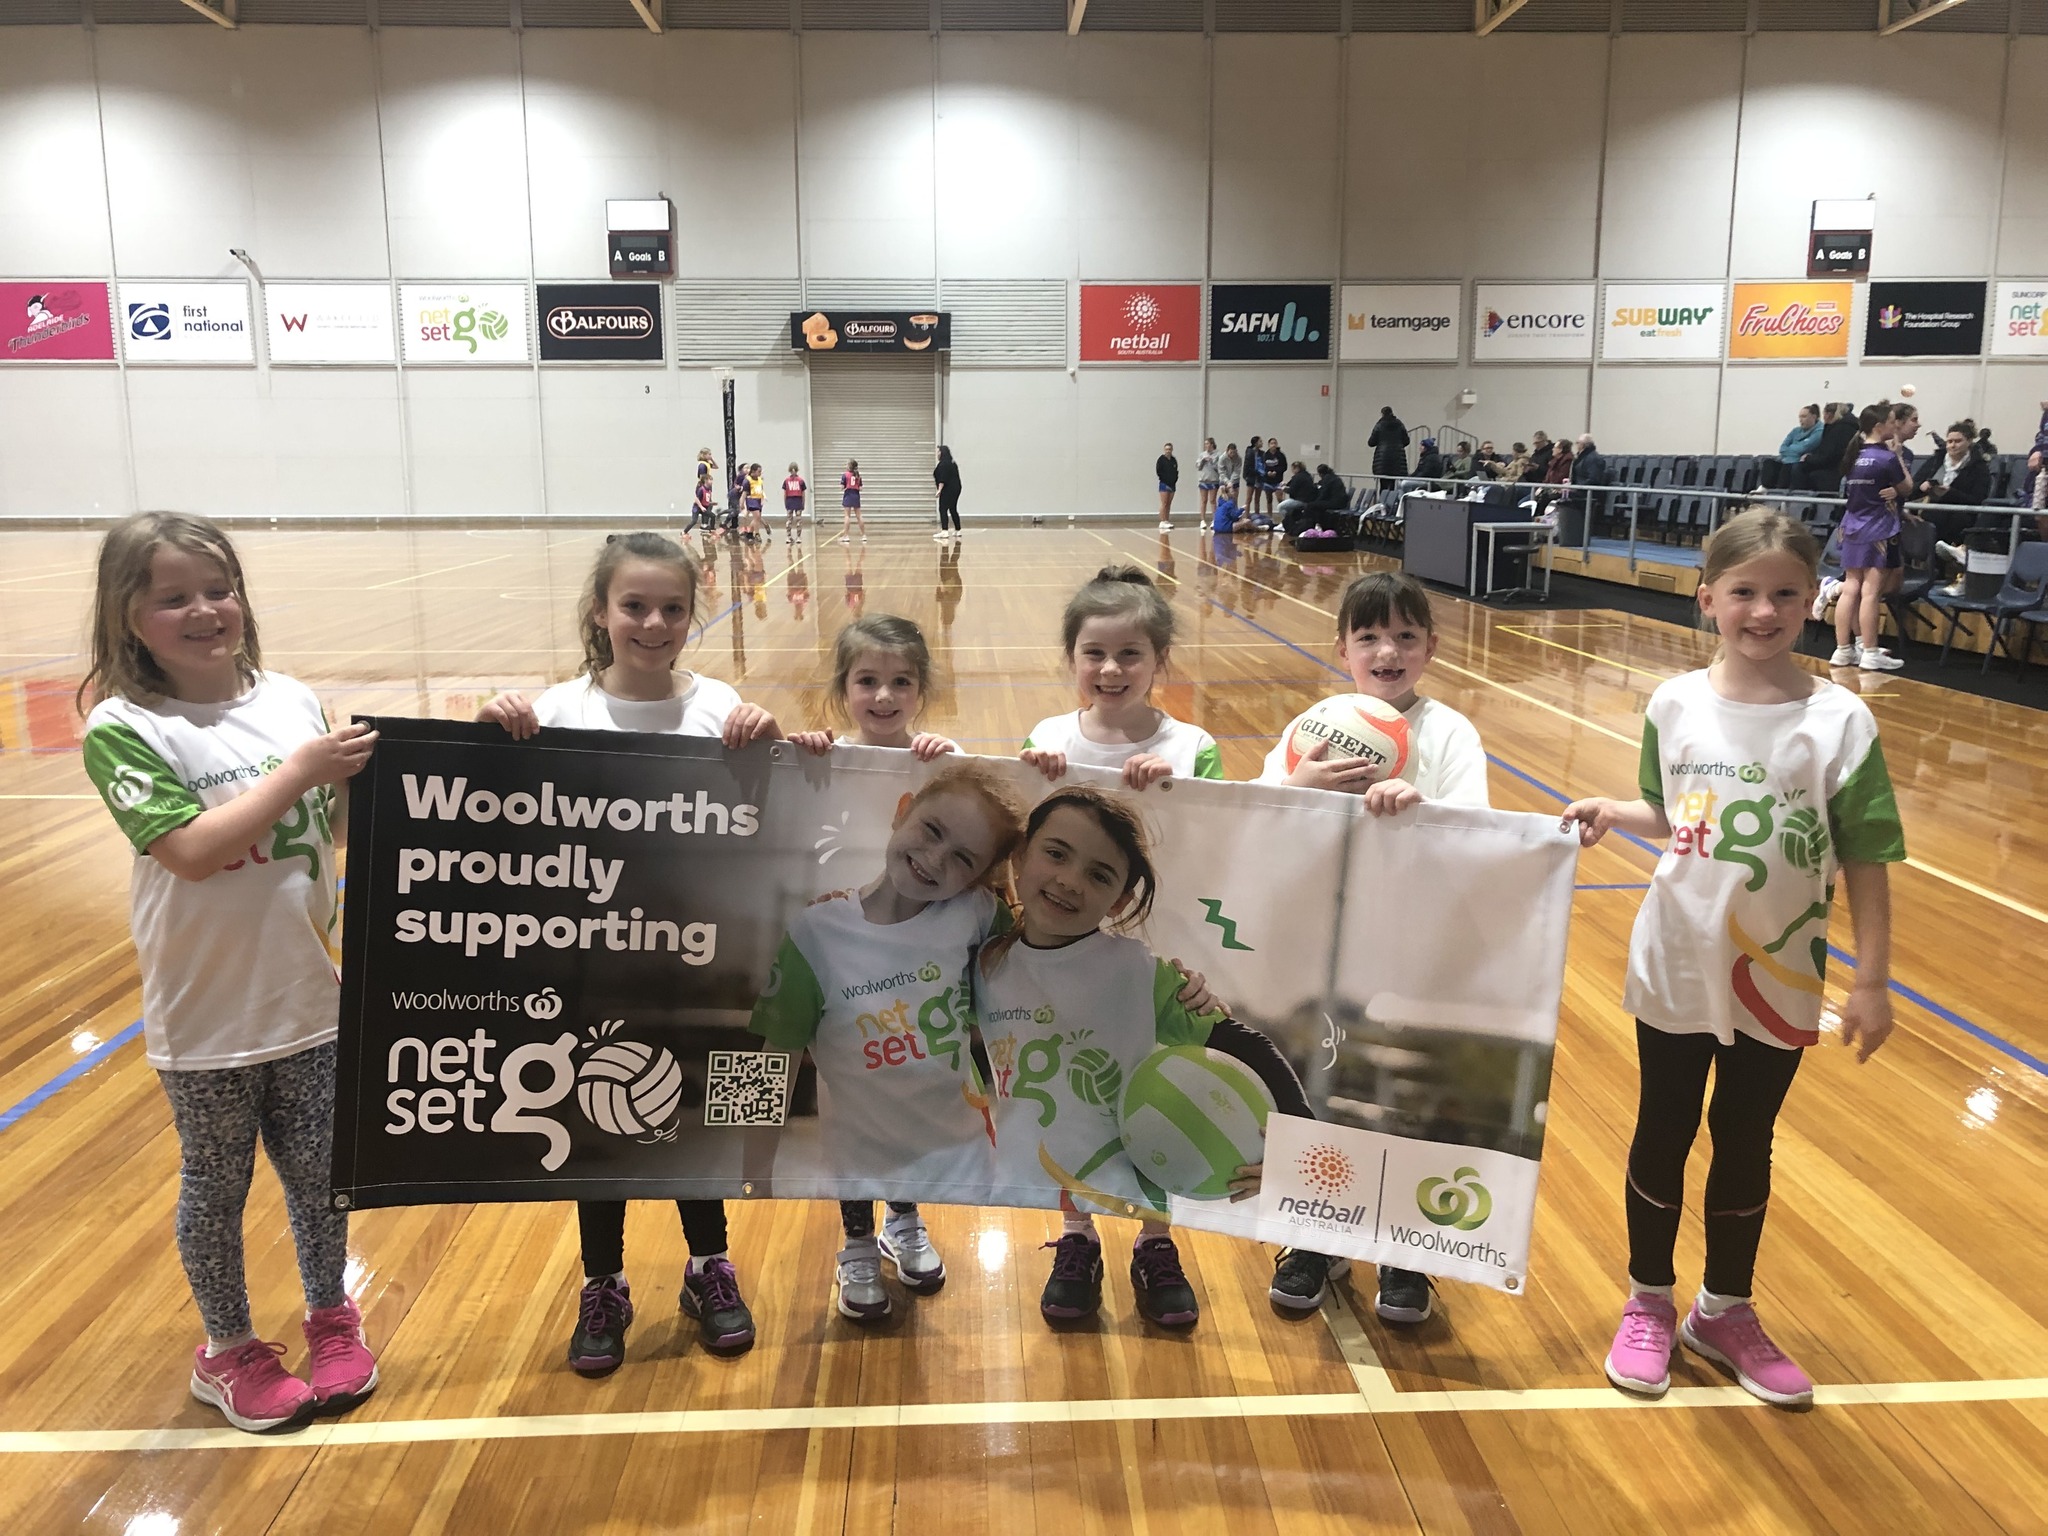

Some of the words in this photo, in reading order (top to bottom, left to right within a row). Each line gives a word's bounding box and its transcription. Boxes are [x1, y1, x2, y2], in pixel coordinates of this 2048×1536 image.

[614, 250, 623, 261] A
[628, 252, 652, 261] Goals
[658, 250, 666, 261] B
[1815, 248, 1825, 260] A
[1858, 248, 1867, 260] B
[183, 305, 207, 317] first
[420, 307, 451, 325] net
[1611, 306, 1714, 327] SUBWAY
[1738, 303, 1845, 337] FruChocs
[1904, 312, 1917, 320] The
[1917, 312, 1944, 321] Hospital
[1944, 312, 1974, 320] Research
[2010, 302, 2042, 320] net
[27, 314, 65, 333] ADELAIDE
[184, 319, 243, 331] national
[550, 310, 649, 335] BALFOURS
[1220, 312, 1280, 333] SAFM
[1371, 314, 1450, 331] teamgage
[1507, 314, 1585, 329] encore
[1903, 320, 1940, 328] Foundation
[1940, 320, 1961, 329] Group
[2008, 319, 2038, 336] set
[8, 313, 91, 353] Thunderbirds
[421, 324, 451, 341] set
[1110, 333, 1171, 349] netball
[644, 385, 650, 394] 3
[1824, 380, 1830, 389] 2
[788, 480, 800, 491] WA
[1301, 719, 1387, 765] GILBERT
[188, 765, 260, 793] oolworths
[402, 773, 760, 837] Woolworths
[397, 844, 625, 904] proudly
[394, 906, 718, 966] supporting
[856, 998, 917, 1038] net
[387, 1028, 496, 1083] net
[863, 1030, 927, 1070] set
[384, 1079, 487, 1135] set
[1278, 1196, 1367, 1226] netball
[1288, 1216, 1353, 1235] AUSTRALIA
